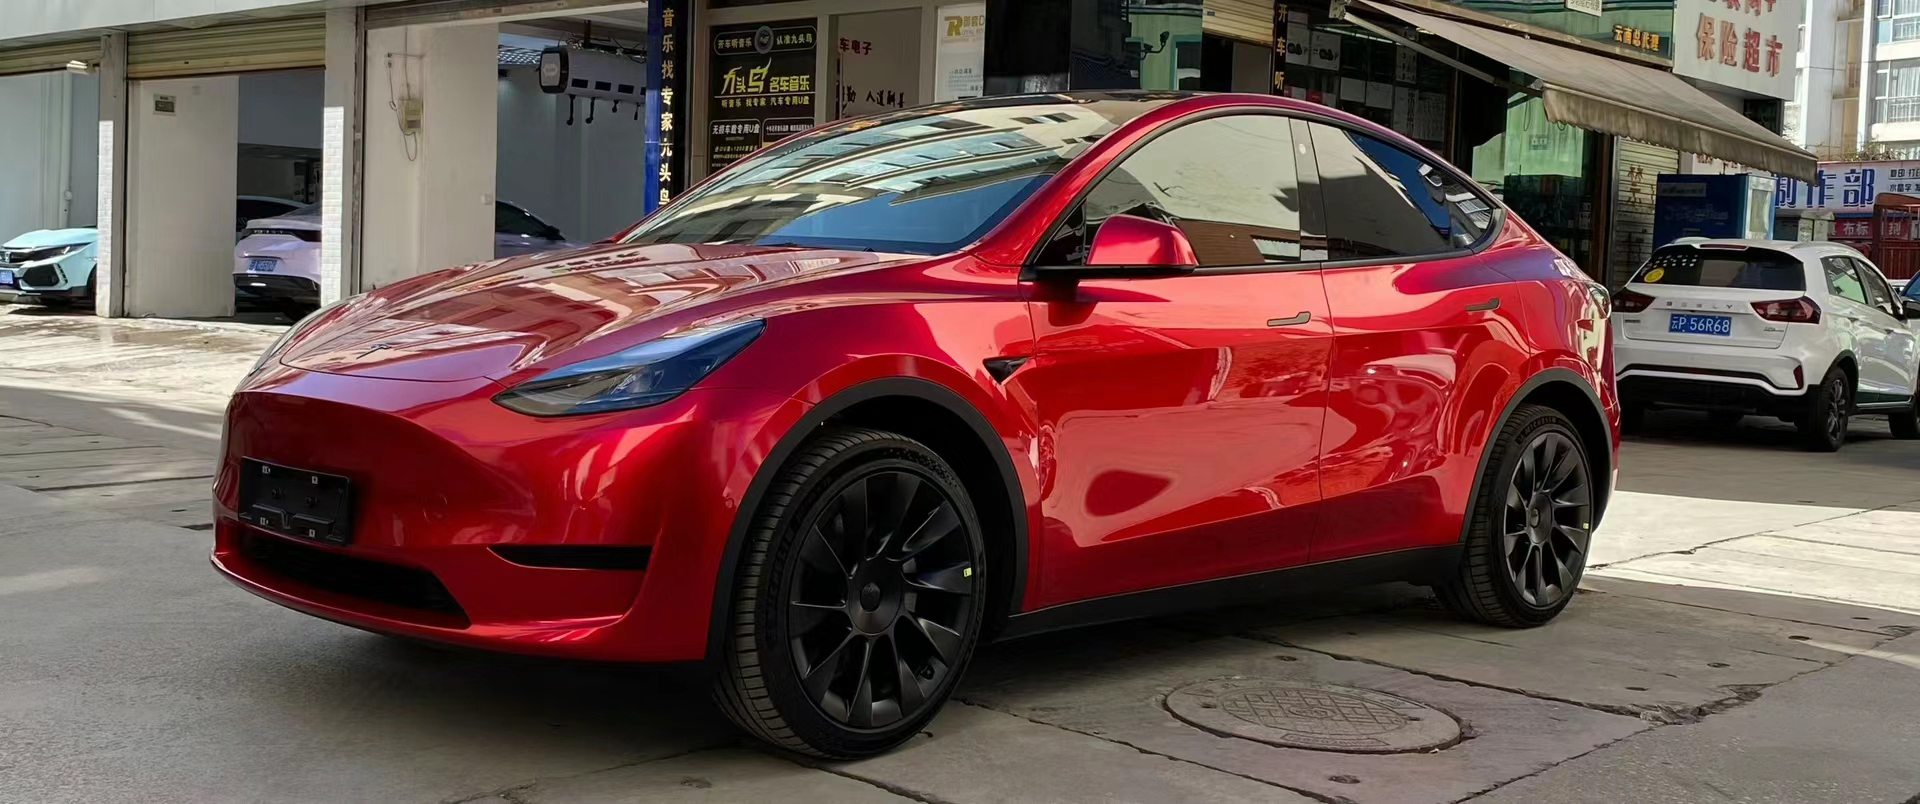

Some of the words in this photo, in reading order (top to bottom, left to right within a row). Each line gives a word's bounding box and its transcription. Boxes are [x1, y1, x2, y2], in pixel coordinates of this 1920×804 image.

[717, 37, 752, 49] 开车听音乐
[776, 33, 813, 45] 认准九头鸟
[840, 37, 872, 55] 车电子
[1275, 4, 1287, 90] 开车听
[1613, 24, 1660, 52] 云南总代理
[1696, 12, 1783, 77] 保险超市
[721, 57, 772, 95] 九头鸟
[769, 75, 810, 93] 名车音乐
[721, 98, 742, 109] 听音乐
[745, 97, 767, 108] 找专家
[770, 96, 810, 107] 汽车专用U盘
[1775, 169, 1875, 208] 制作部
[1889, 183, 1912, 193] 水晶字
[1843, 221, 1869, 236] 布标
